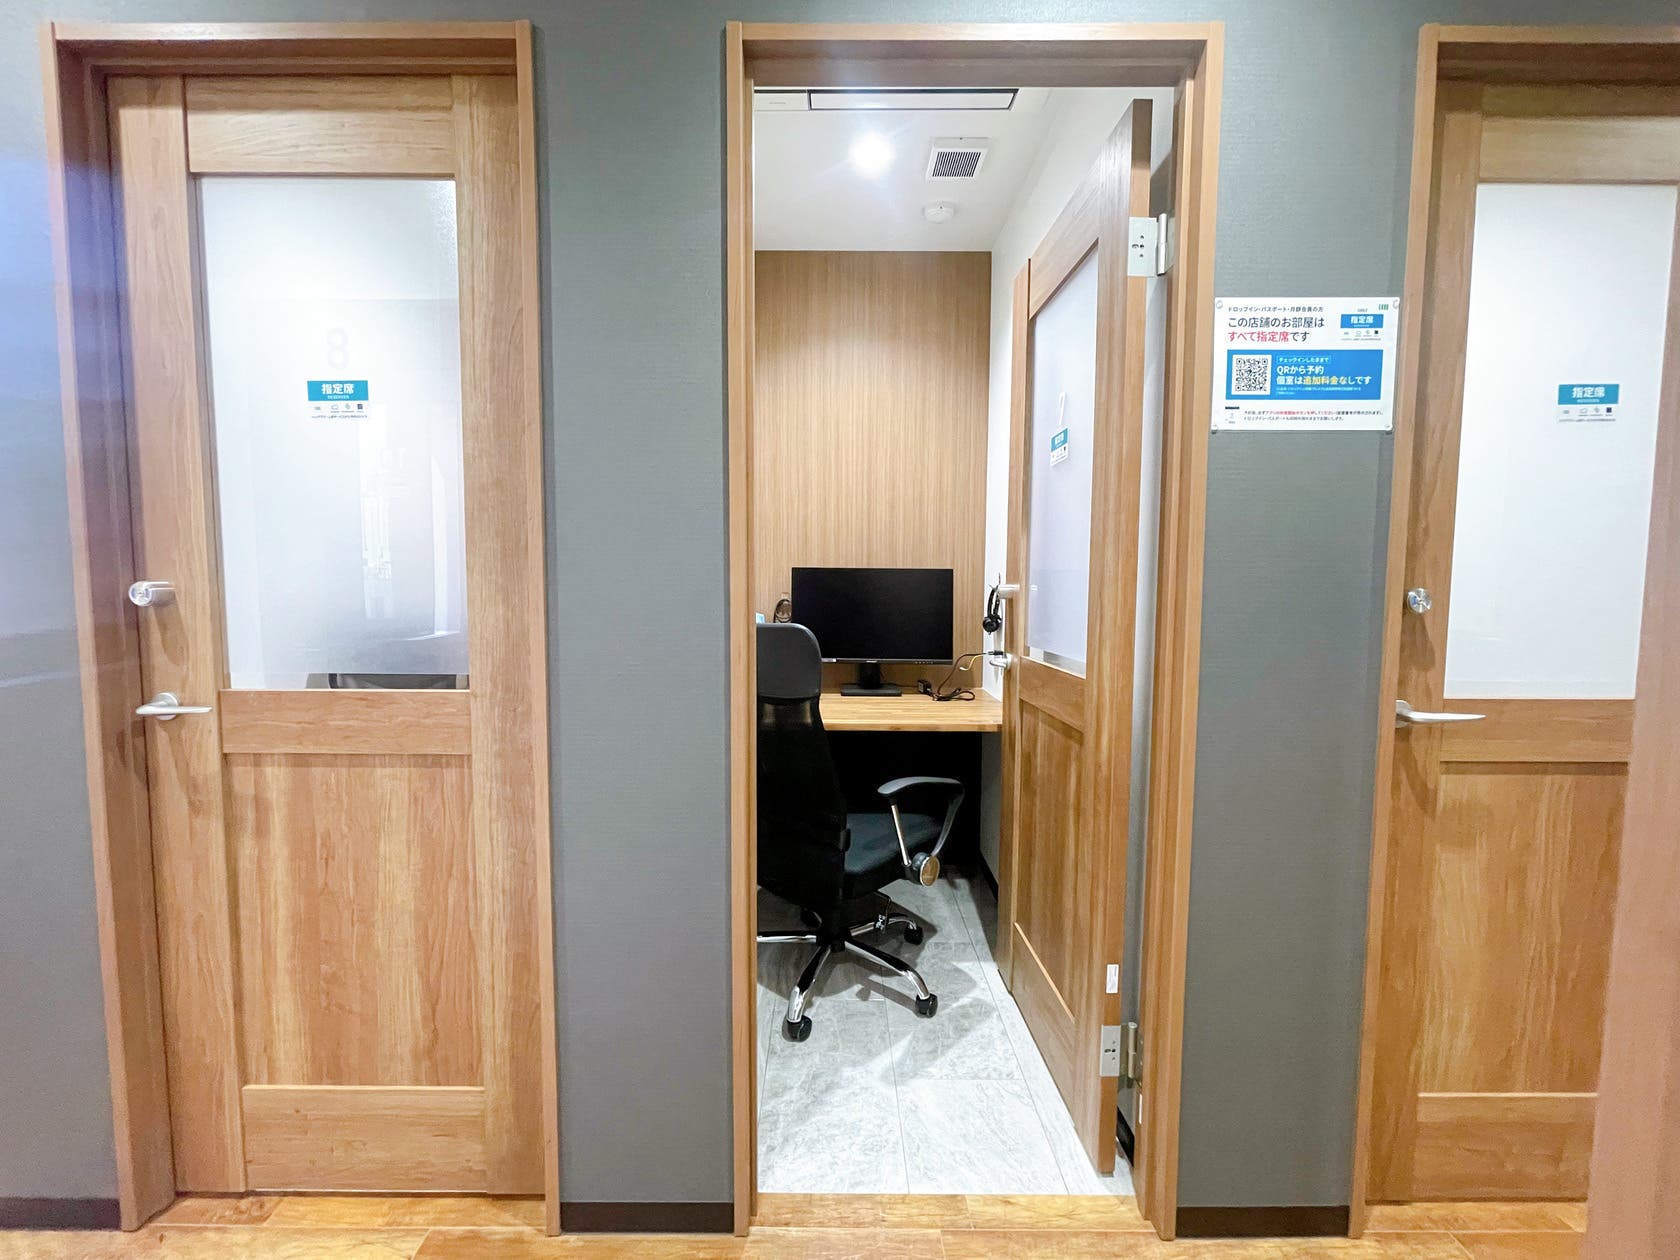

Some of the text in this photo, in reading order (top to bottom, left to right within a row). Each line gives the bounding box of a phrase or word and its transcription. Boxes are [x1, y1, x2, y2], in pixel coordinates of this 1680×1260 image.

[1228, 317, 1325, 328] この店舗のお部屋は
[1227, 331, 1310, 342] すべて指定席です
[325, 327, 350, 369] 8
[1276, 365, 1325, 375] QRから予約
[1276, 376, 1372, 385] 個室は追加料金なしです
[321, 383, 355, 395] 指定席
[1572, 386, 1606, 398] 指定席
